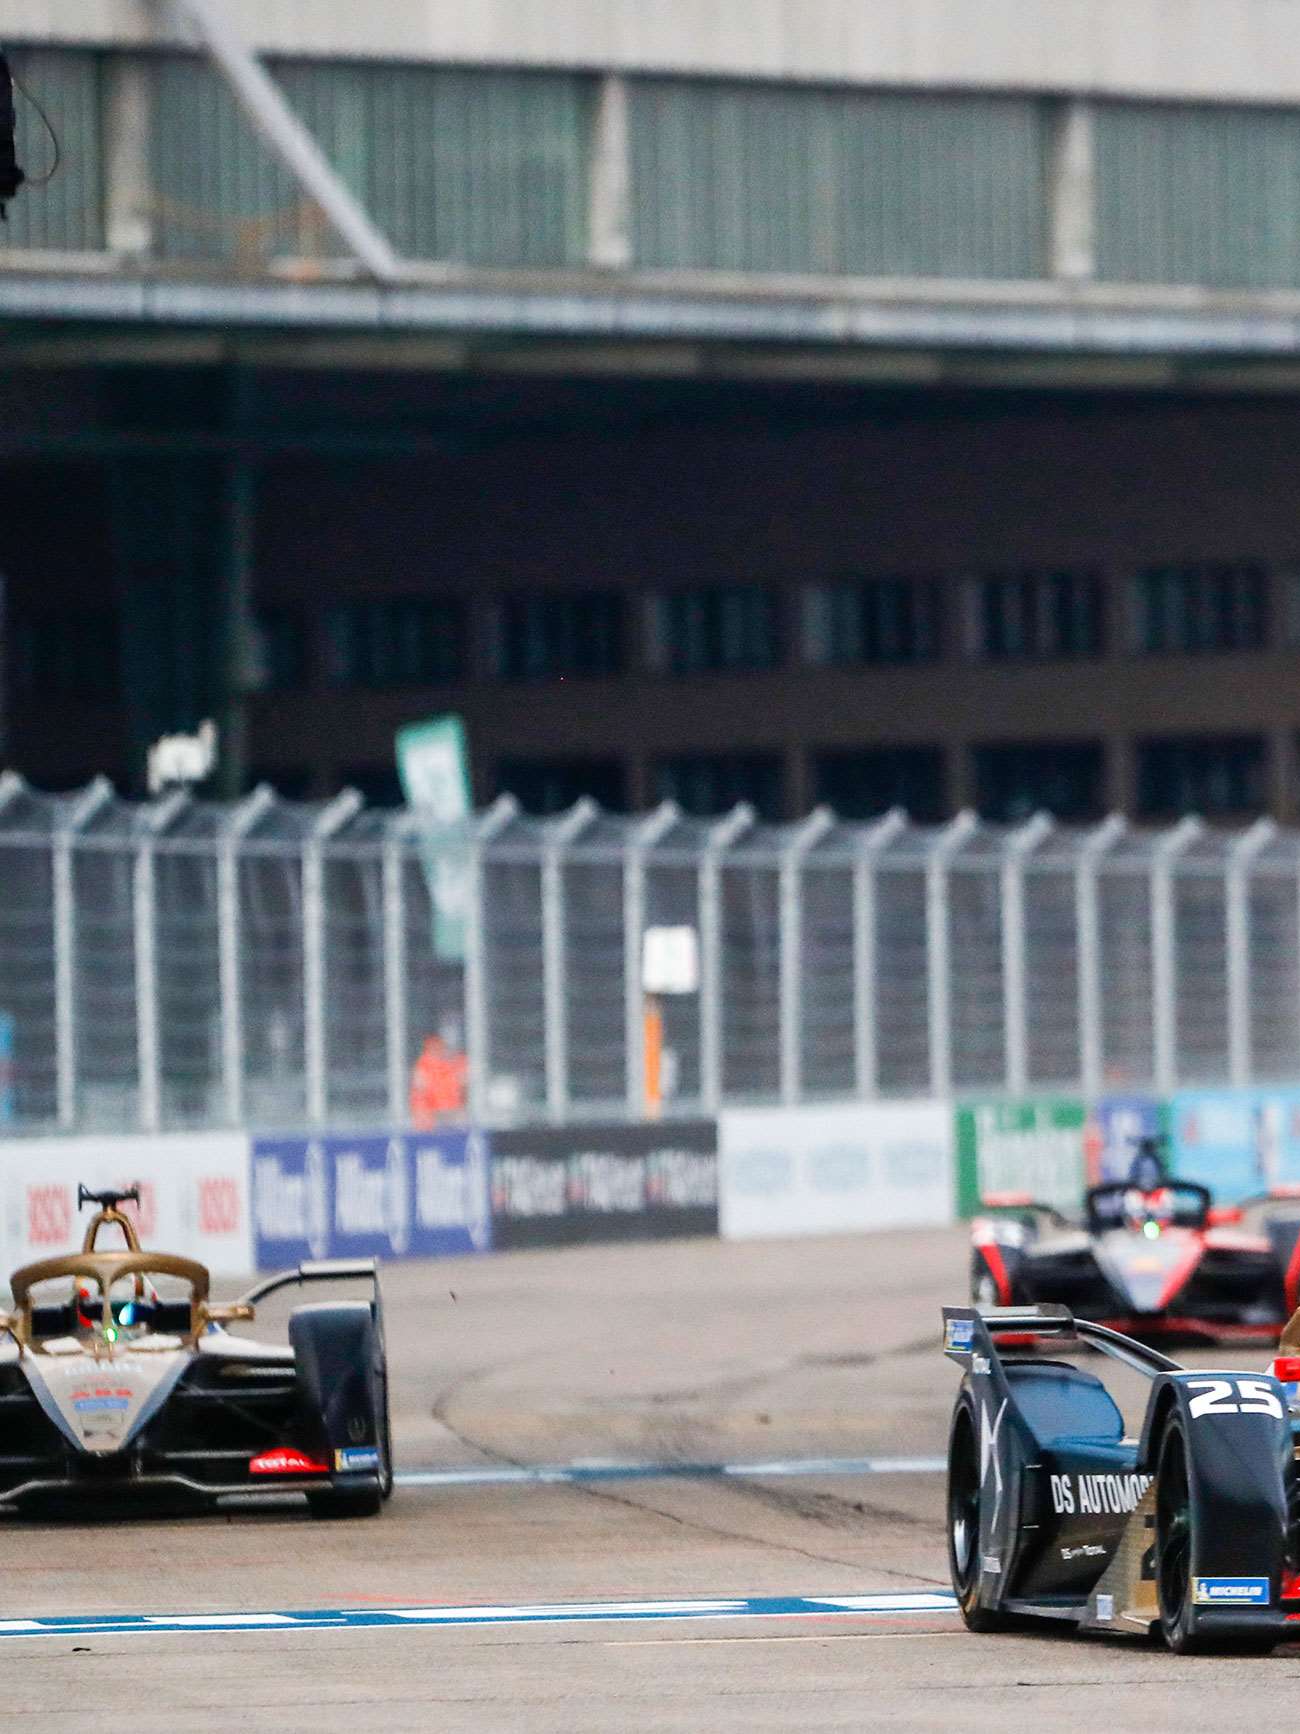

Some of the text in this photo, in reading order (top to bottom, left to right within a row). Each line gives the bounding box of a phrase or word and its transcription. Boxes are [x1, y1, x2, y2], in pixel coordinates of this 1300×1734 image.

[1187, 1380, 1284, 1420] 25
[1050, 1474, 1154, 1514] DS AUTOMO
